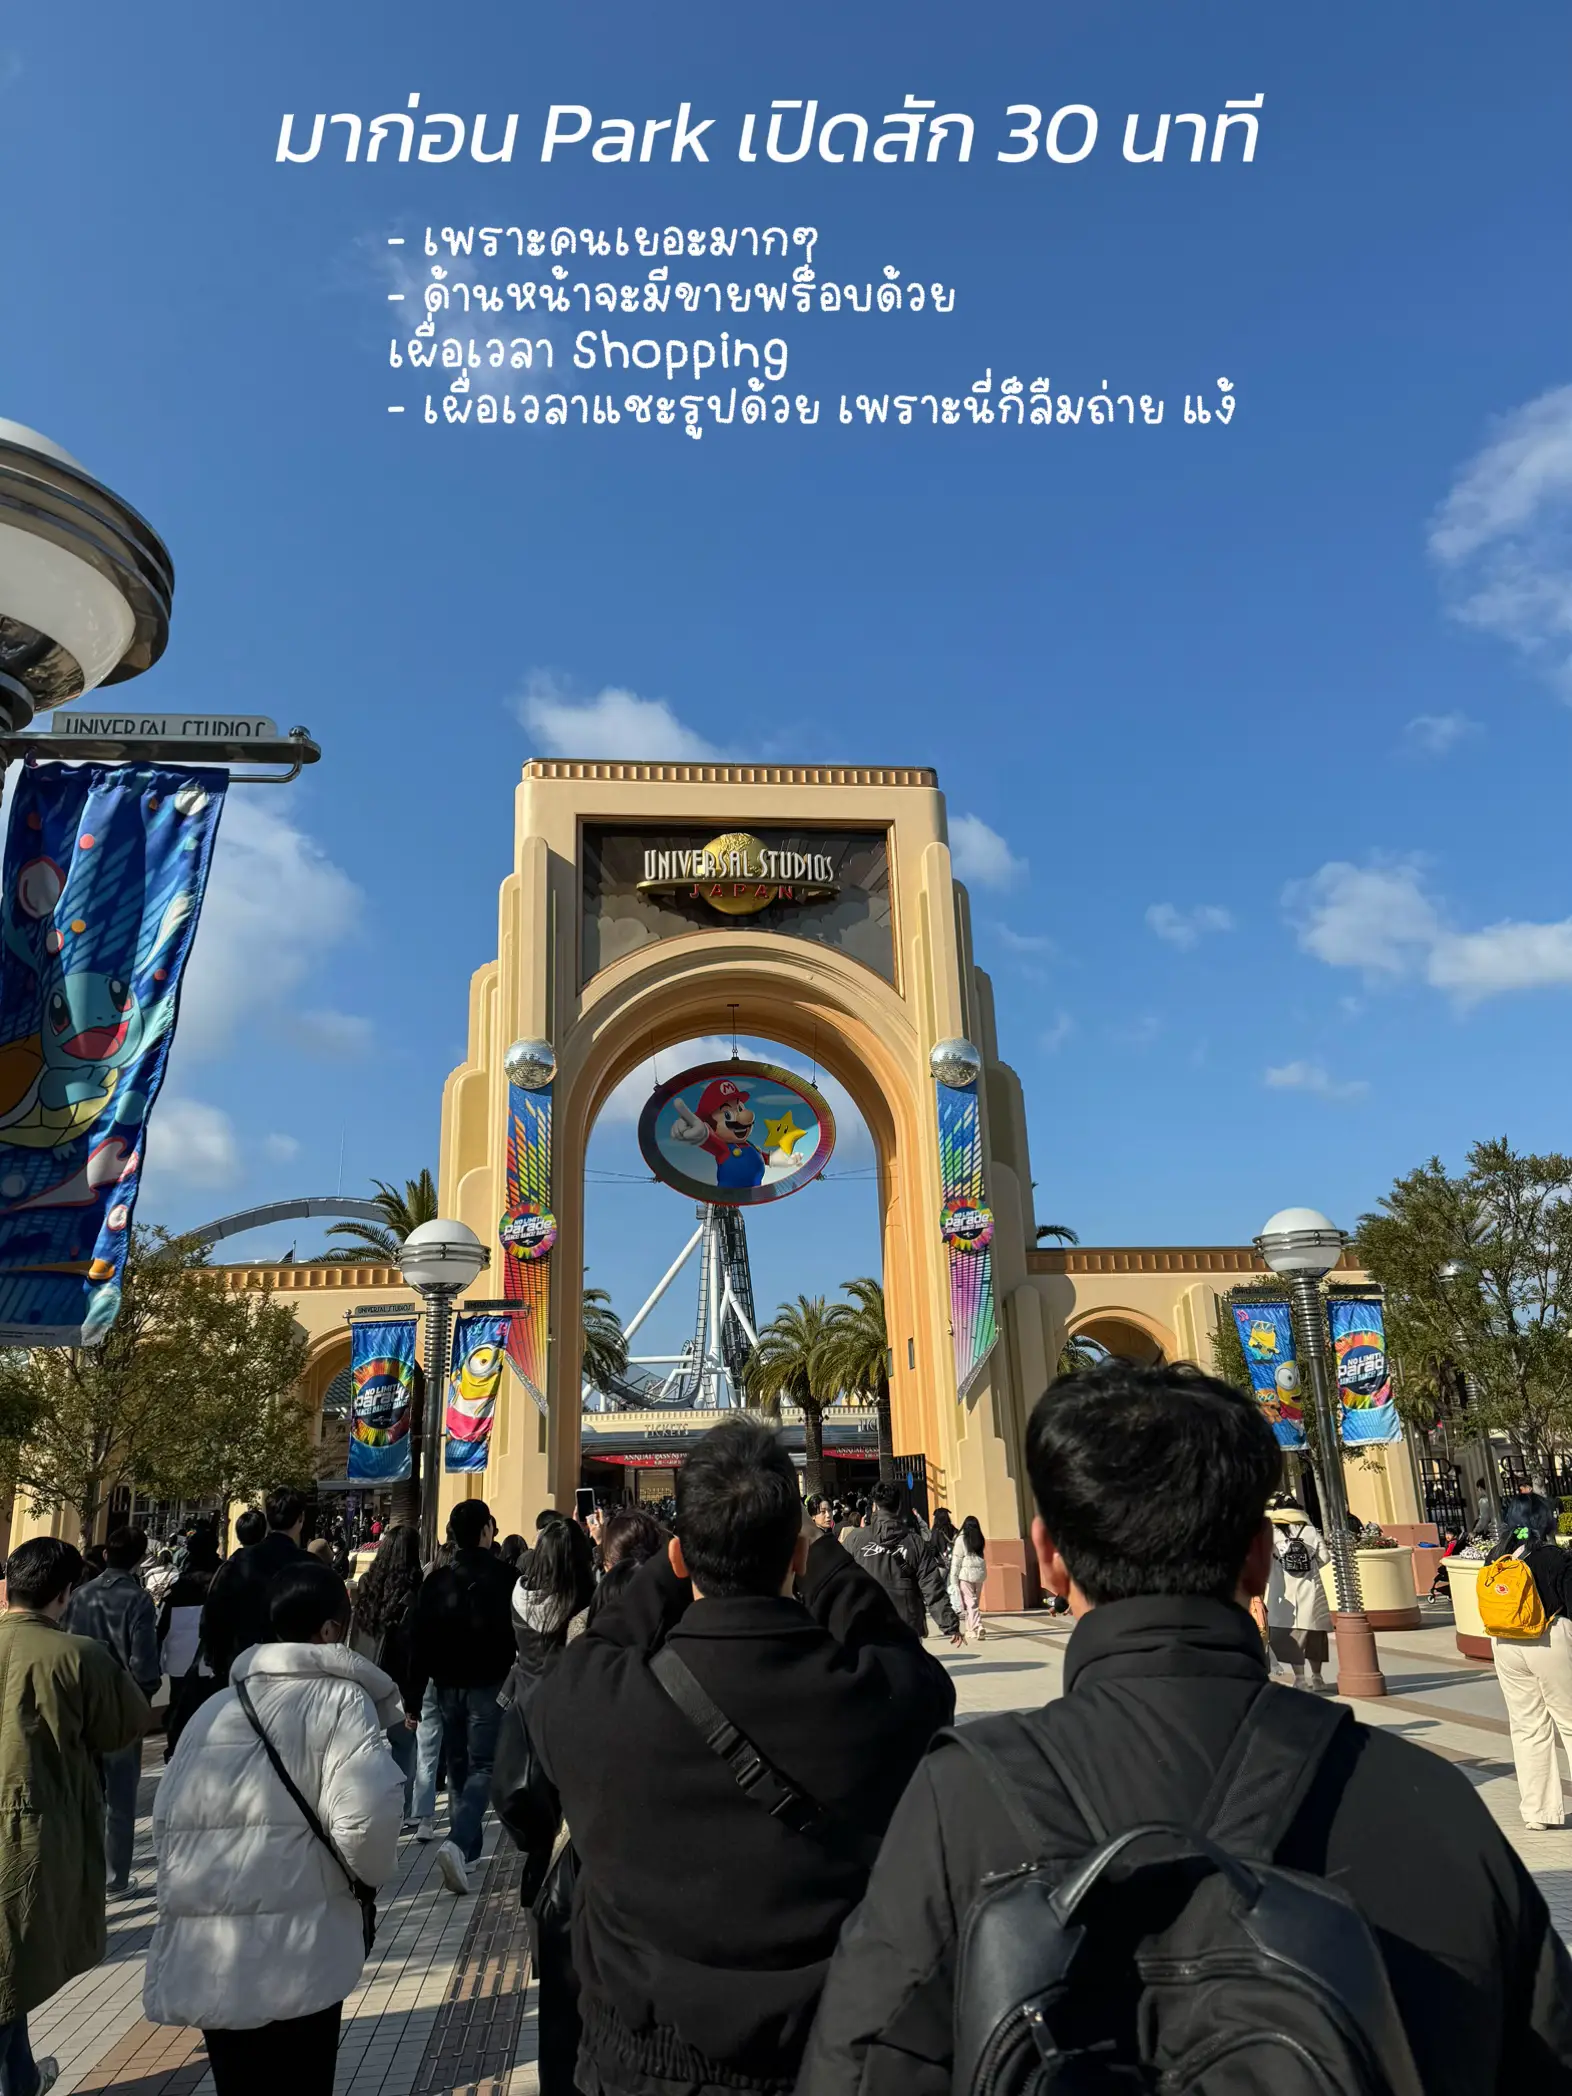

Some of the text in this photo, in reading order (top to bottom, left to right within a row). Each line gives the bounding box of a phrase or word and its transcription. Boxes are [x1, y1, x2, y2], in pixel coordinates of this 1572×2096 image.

[644, 849, 834, 882] UNIVERSAL STUDIOS
[689, 884, 794, 900] JAPAN
[358, 1305, 386, 1314] UNIVERSAL
[1338, 1356, 1385, 1379] Parad
[1347, 1357, 1358, 1367] NO
[365, 1388, 376, 1398] NO
[644, 1423, 689, 1438] TICKETS
